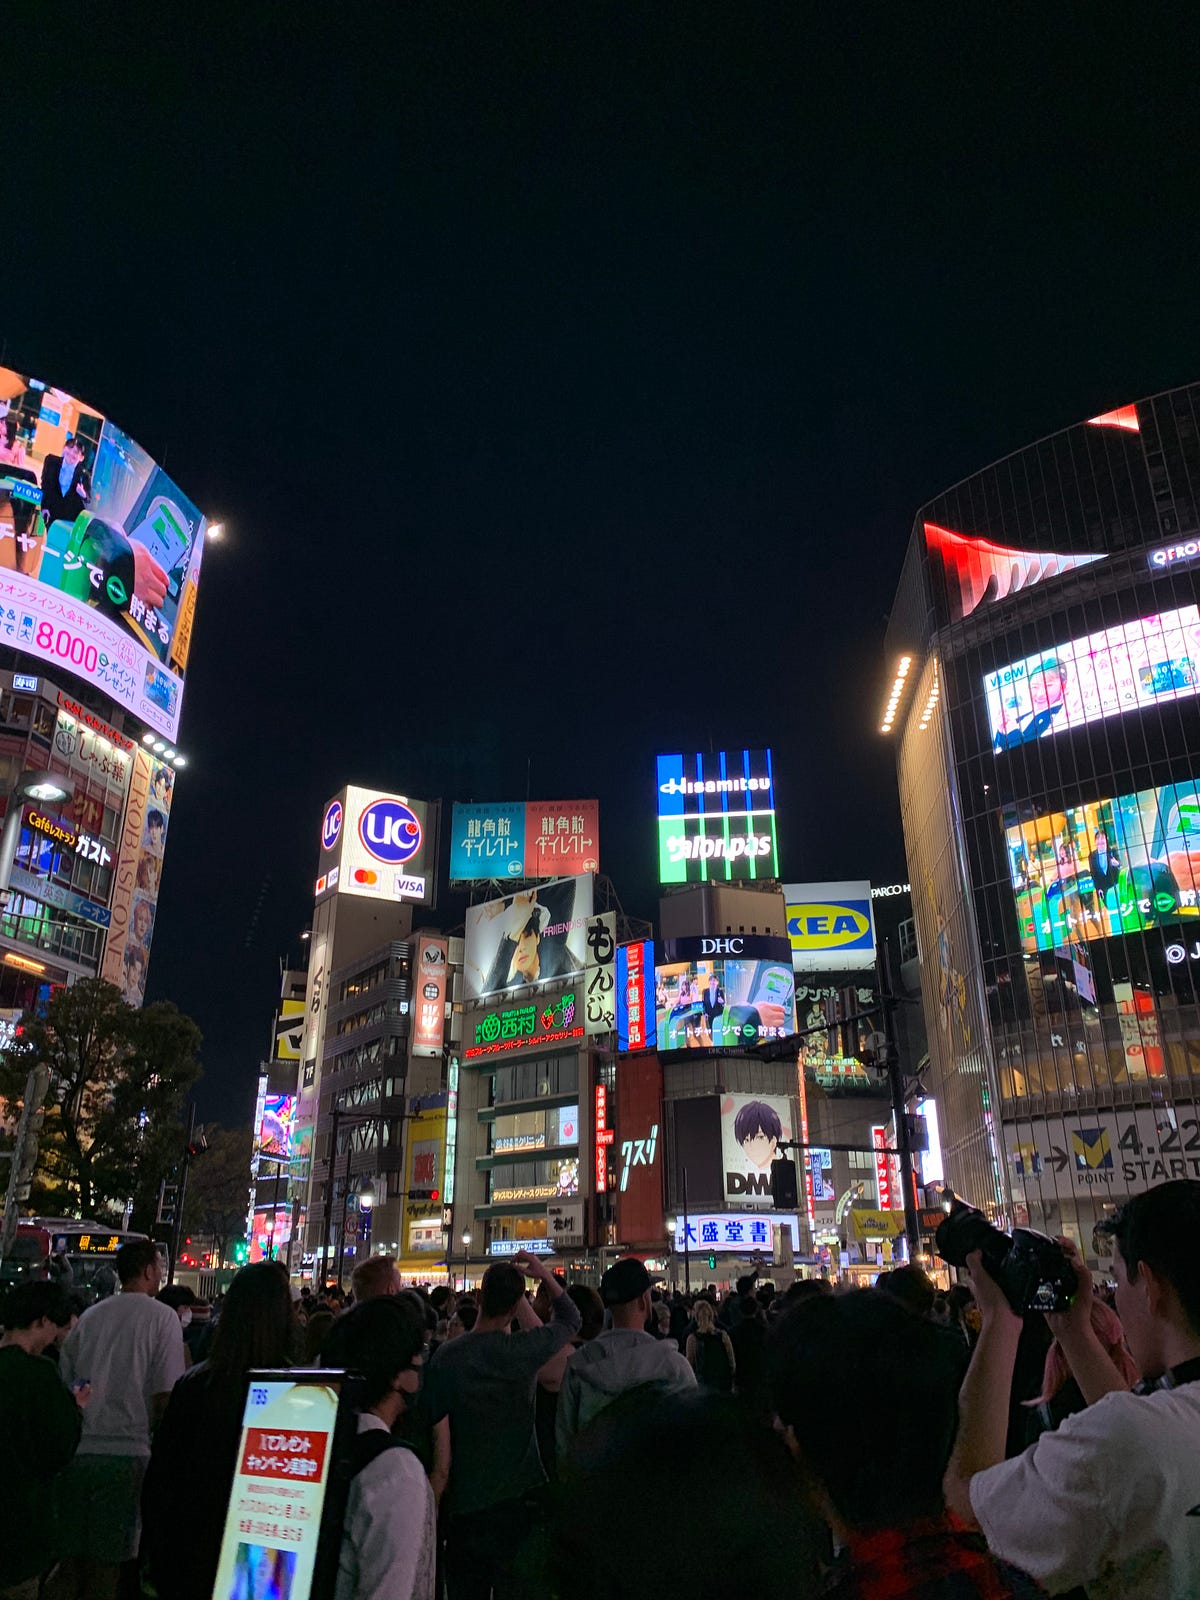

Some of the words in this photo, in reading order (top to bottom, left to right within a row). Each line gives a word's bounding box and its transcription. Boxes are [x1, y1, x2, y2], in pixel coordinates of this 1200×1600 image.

[1153, 542, 1200, 565] QFRO
[130, 593, 170, 645] 貯まる
[467, 817, 511, 838] 龍角散
[541, 815, 585, 835] 龍角散
[76, 834, 112, 867] ガスト
[461, 838, 518, 857] ダイレクト
[535, 836, 593, 855] ダイレクト
[398, 879, 424, 893] VISA
[870, 884, 902, 898] PARCO
[787, 916, 861, 935] KEA
[701, 938, 744, 954] DHC
[587, 917, 616, 1029] もんじゃ
[627, 947, 641, 1043] 三千里薬品
[501, 1014, 536, 1039] 西村
[669, 1026, 741, 1039] オートチャージで
[757, 1025, 786, 1038] 貯まる
[1118, 1119, 1200, 1156] 4.22
[620, 1124, 658, 1192] クスリ
[1123, 1156, 1200, 1182] START
[726, 1172, 773, 1195] DM
[1078, 1172, 1116, 1185] POINT
